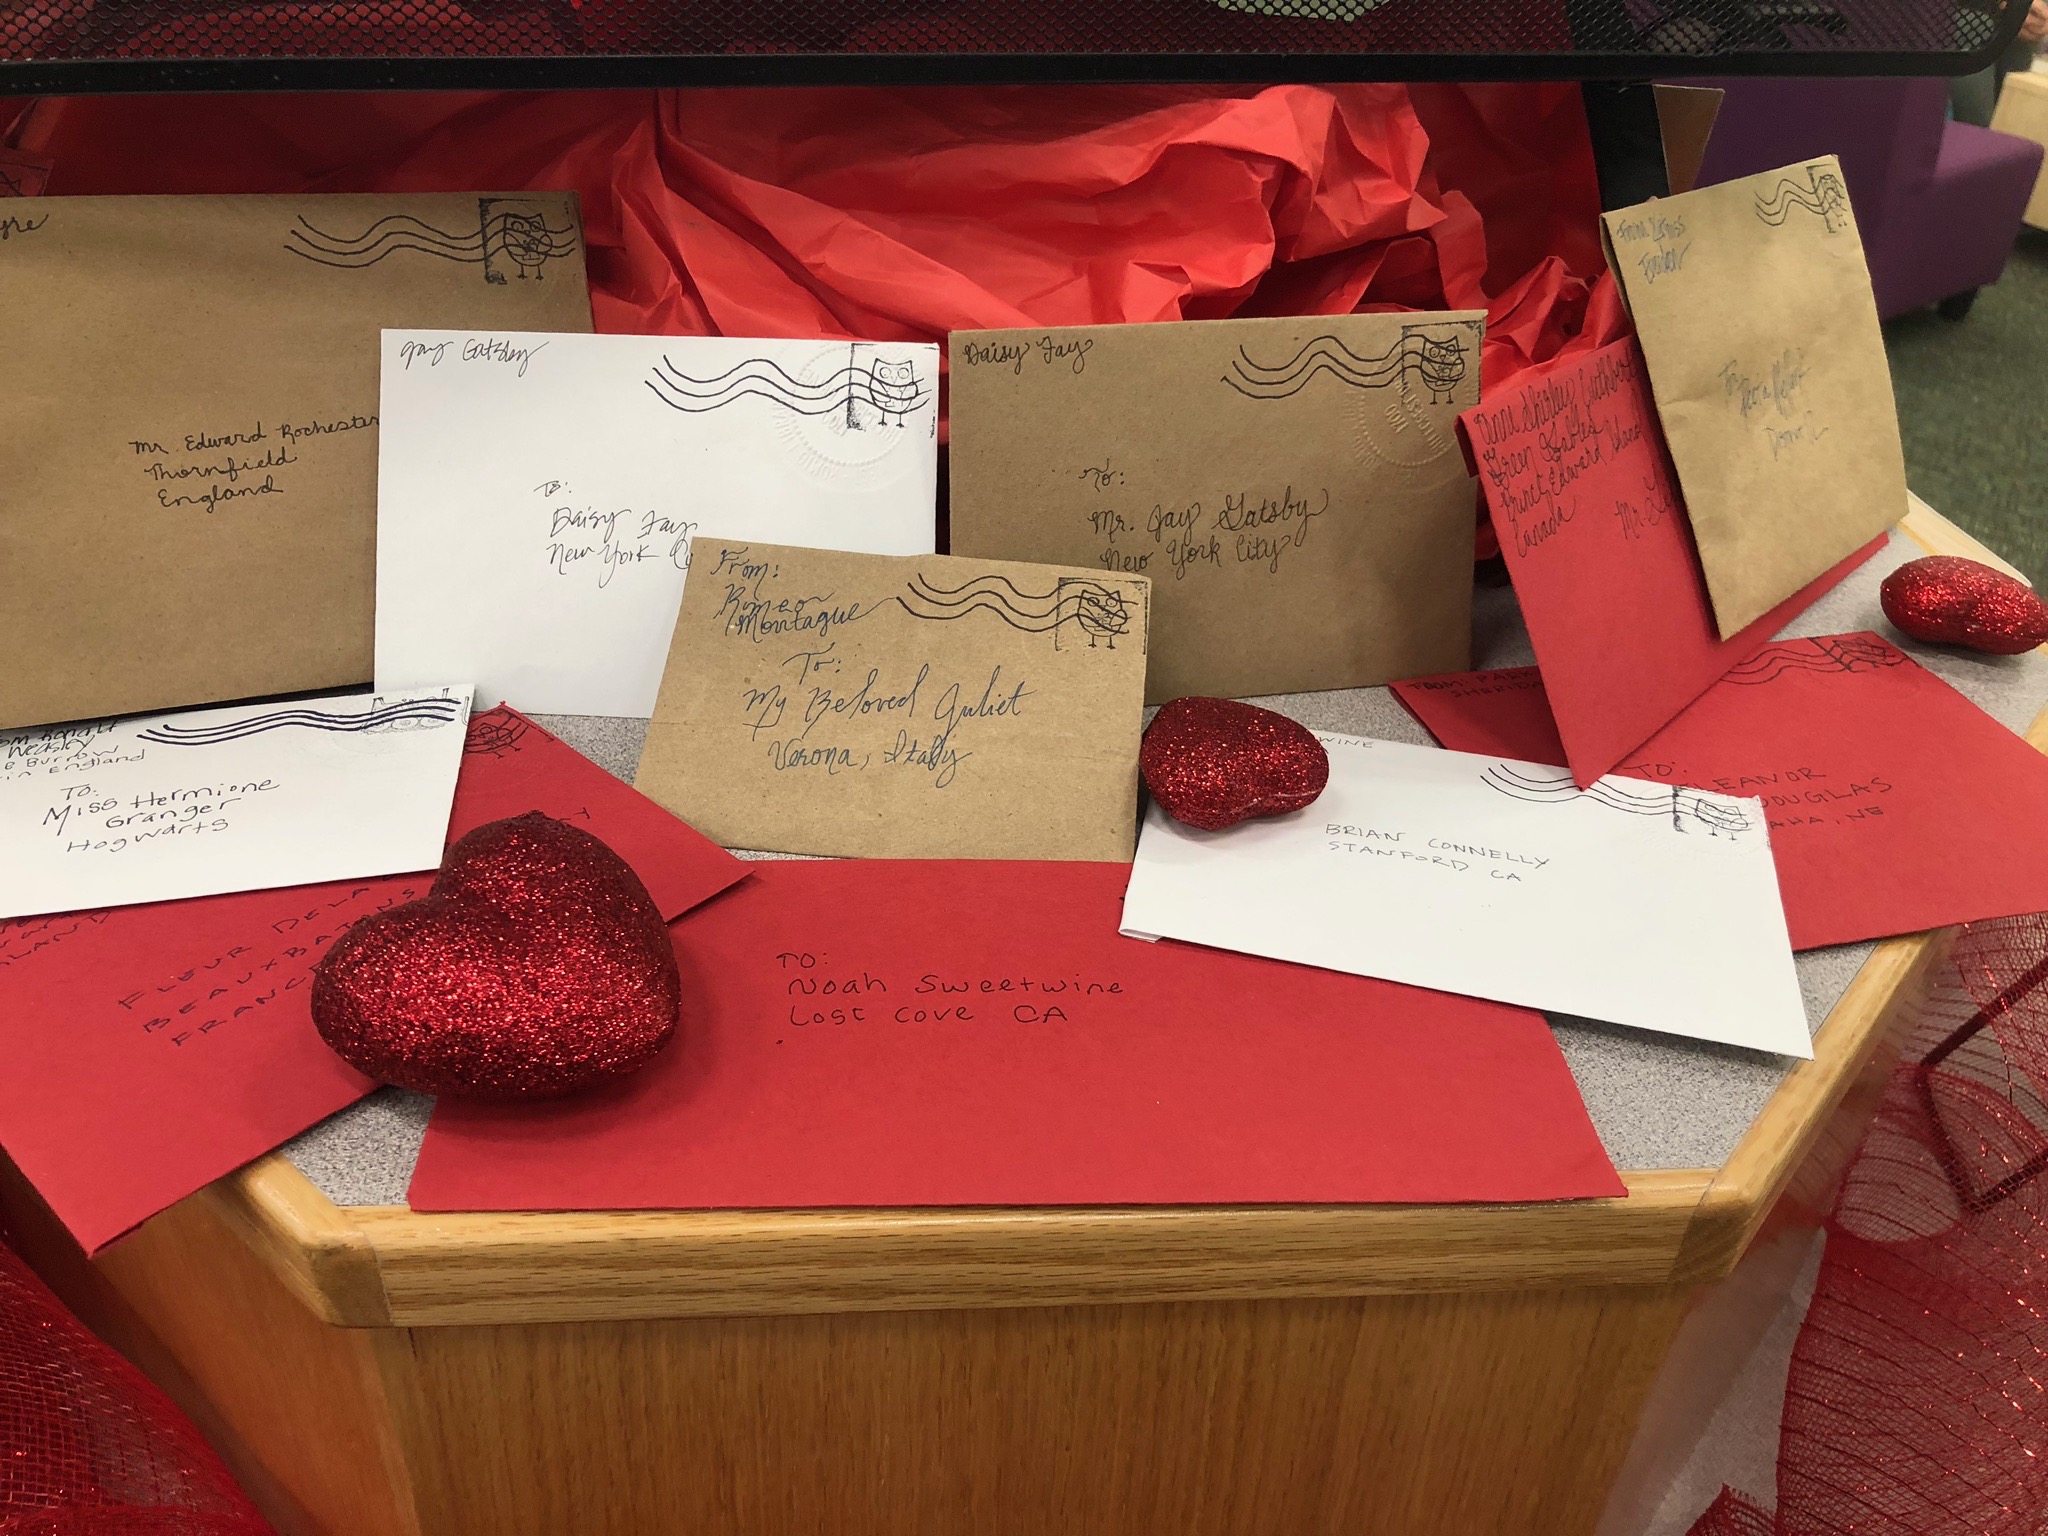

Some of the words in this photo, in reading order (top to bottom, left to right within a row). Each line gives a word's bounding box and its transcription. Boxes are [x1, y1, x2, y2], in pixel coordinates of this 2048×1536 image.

[0, 213, 49, 240] yre
[964, 341, 1031, 375] Daisy
[185, 421, 267, 452] Edward
[275, 415, 380, 444] Rochester
[144, 446, 298, 482] Thornfield
[158, 474, 284, 514] England
[550, 506, 632, 544] Daisy
[1146, 502, 1201, 545] Jay
[1211, 486, 1330, 548] Gatsby
[546, 543, 596, 575] New
[597, 541, 660, 589] York
[1166, 535, 1222, 581] York
[1236, 534, 1291, 574] City
[713, 583, 836, 637] Romeo
[725, 596, 898, 644] Montague
[782, 642, 842, 685] To:
[743, 684, 787, 742] My
[801, 663, 930, 740] Beloved
[934, 665, 1038, 742] Juliet
[49, 749, 145, 774] England
[883, 729, 974, 789] Italy
[1678, 767, 1827, 792] LEANOR
[42, 798, 118, 836] Miss
[130, 778, 281, 809] Hermione
[105, 797, 242, 830] Granger
[66, 818, 229, 853] Hogwarts
[1325, 823, 1406, 842] BRIAN
[1428, 838, 1549, 870] CONNELLY
[1328, 841, 1469, 871] STANFORD
[1491, 869, 1522, 882] CA
[118, 944, 252, 1011] FLEUR
[788, 972, 888, 996] Noah
[915, 973, 1125, 996] Sweetwine
[790, 1005, 867, 1027] Lost
[1013, 1004, 1069, 1025] CA
